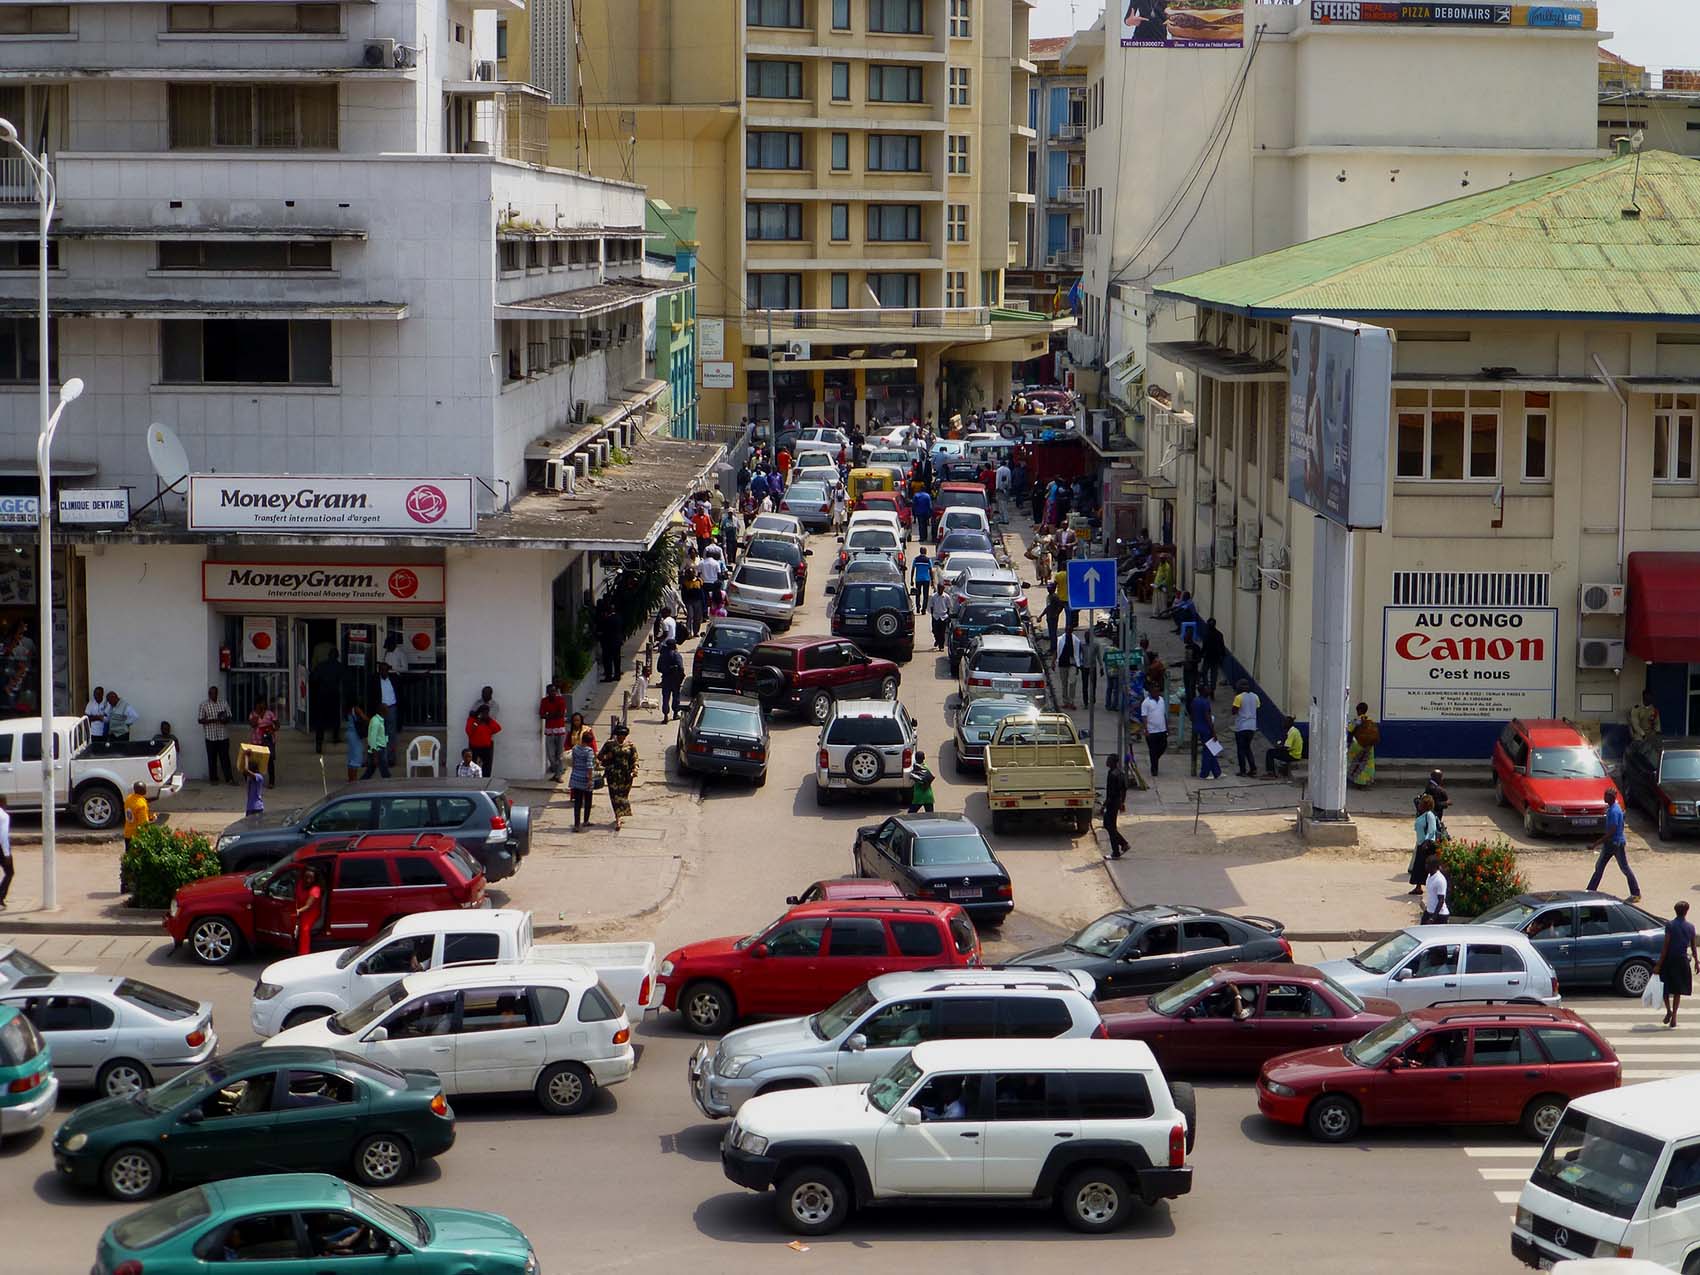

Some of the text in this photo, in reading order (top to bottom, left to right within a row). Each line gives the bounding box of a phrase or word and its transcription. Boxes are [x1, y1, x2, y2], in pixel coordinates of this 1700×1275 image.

[1313, 2, 1360, 20] STEERS
[1402, 7, 1490, 20] PIZZA DEBONAIRS
[0, 499, 35, 513] GEC
[60, 500, 125, 511] CLINIQUE DENTAIRE
[220, 489, 368, 512] MoneyGram
[254, 514, 381, 524] Transfert international d'argent
[227, 569, 373, 591] MoneyGram
[267, 589, 385, 599] International Money Transfer
[1415, 613, 1523, 628] AU CONGO
[1395, 632, 1544, 661] Canon
[1429, 667, 1511, 680] C'est nous
